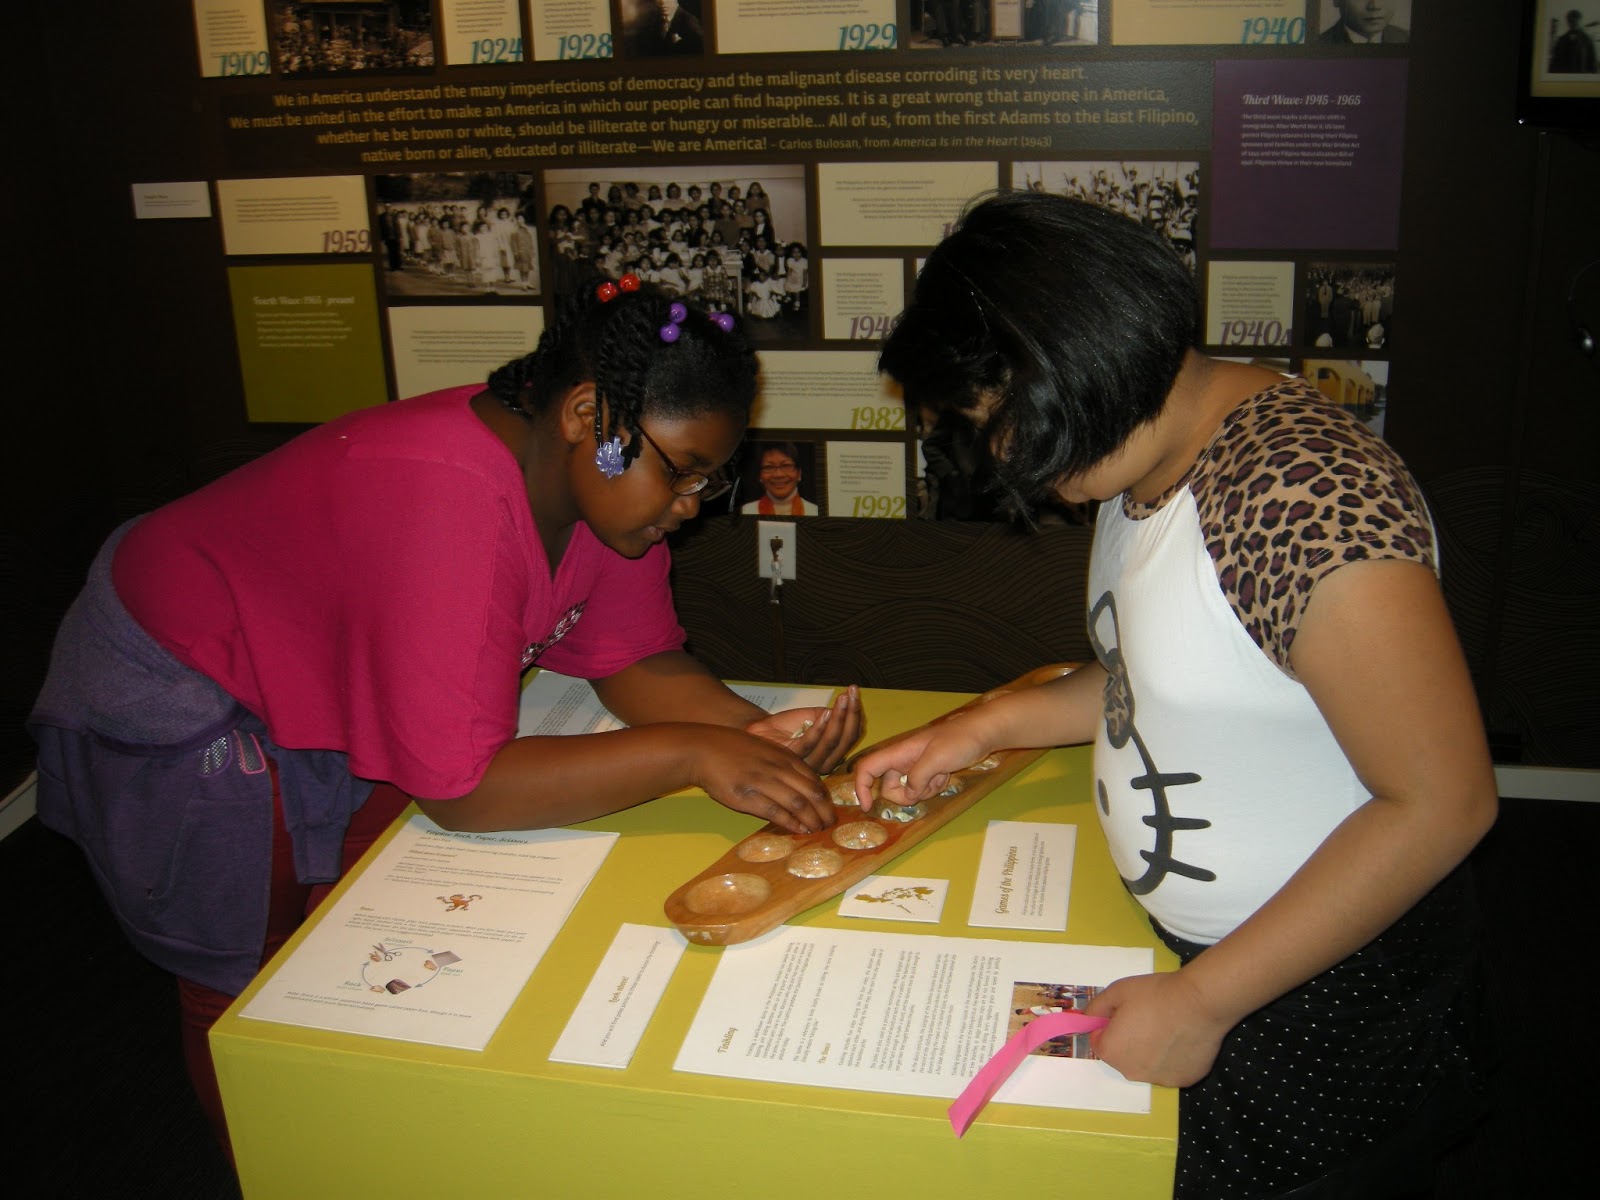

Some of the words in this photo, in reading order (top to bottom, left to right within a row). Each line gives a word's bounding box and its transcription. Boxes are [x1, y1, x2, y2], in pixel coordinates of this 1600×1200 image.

[839, 23, 897, 50] 1929
[1240, 16, 1306, 45] 1940
[471, 37, 523, 64] 1924
[558, 33, 613, 60] 1928
[219, 51, 271, 76] 1909
[275, 92, 295, 107] We
[298, 92, 309, 105] in
[312, 88, 363, 105] America
[366, 86, 441, 102] understand
[444, 84, 467, 98] the
[471, 84, 507, 100] many
[511, 78, 605, 98] imperfections
[609, 78, 623, 92] of
[627, 74, 704, 94] democracy
[708, 74, 735, 88] and
[739, 74, 763, 87] the
[768, 70, 841, 89] malignant
[846, 70, 901, 84] disease
[905, 68, 977, 86] corroding
[981, 68, 1001, 81] its
[1005, 70, 1038, 84] very
[1041, 66, 1088, 80] heart.
[1242, 94, 1270, 105] Third
[1271, 94, 1303, 105] Wave:
[1304, 94, 1329, 106] 1945
[1337, 94, 1361, 106] 1965
[231, 114, 249, 129] We
[253, 112, 283, 128] must
[286, 112, 301, 126] be
[305, 110, 345, 125] united
[348, 110, 361, 123] in
[363, 108, 385, 123] the
[387, 106, 425, 121] effort
[428, 106, 443, 120] to
[447, 104, 481, 119] make
[485, 106, 502, 117] an
[506, 100, 561, 116] America
[565, 100, 577, 114] in
[581, 98, 621, 114] which
[625, 100, 649, 112] our
[653, 96, 701, 114] people
[705, 98, 729, 110] can
[733, 94, 761, 109] find
[767, 92, 843, 111] happiness.
[849, 92, 859, 106] It
[865, 92, 875, 106] is
[879, 94, 888, 105] a
[893, 90, 931, 108] great
[936, 92, 983, 107] wrong
[987, 90, 1019, 103] that
[1024, 92, 1079, 106] anyone
[1083, 88, 1098, 102] in
[1103, 88, 1169, 105] America,
[319, 128, 370, 144] whether
[373, 128, 389, 142] he
[393, 128, 409, 141] be
[412, 126, 453, 140] brown
[457, 128, 471, 139] or
[475, 124, 515, 141] white,
[519, 122, 565, 136] should
[569, 120, 585, 135] be
[589, 118, 647, 134] illiterate
[651, 120, 665, 132] or
[670, 116, 719, 135] hungry
[723, 118, 738, 130] or
[743, 114, 825, 130] miserable...
[829, 114, 847, 128] All
[852, 114, 866, 127] of
[871, 116, 891, 130] us,
[896, 112, 931, 126] from
[935, 112, 961, 126] the
[965, 112, 995, 125] first
[1000, 110, 1051, 125] Adams
[1054, 110, 1071, 124] to
[1075, 110, 1101, 124] the
[1105, 110, 1134, 124] last
[1137, 110, 1199, 126] Filipino,
[362, 148, 402, 163] native
[405, 146, 435, 161] born
[439, 148, 452, 160] or
[456, 144, 491, 162] alien,
[495, 142, 557, 158] educated
[561, 144, 575, 156] or
[679, 140, 701, 152] are
[705, 136, 767, 152] America!
[780, 138, 813, 150] Carlos
[816, 136, 861, 152] Bulosan,
[865, 136, 889, 148] from
[893, 136, 937, 148] America
[940, 136, 949, 147] Is
[953, 136, 962, 147] in
[966, 134, 983, 147] the
[987, 134, 1018, 146] Heart
[1022, 134, 1052, 149] (1943)
[320, 229, 371, 253] 1959
[851, 407, 906, 430] 1982
[853, 495, 906, 519] 1992
[995, 894, 1009, 914] Games
[1003, 845, 1019, 876] Philippines
[718, 1026, 739, 1054] Tinikling
